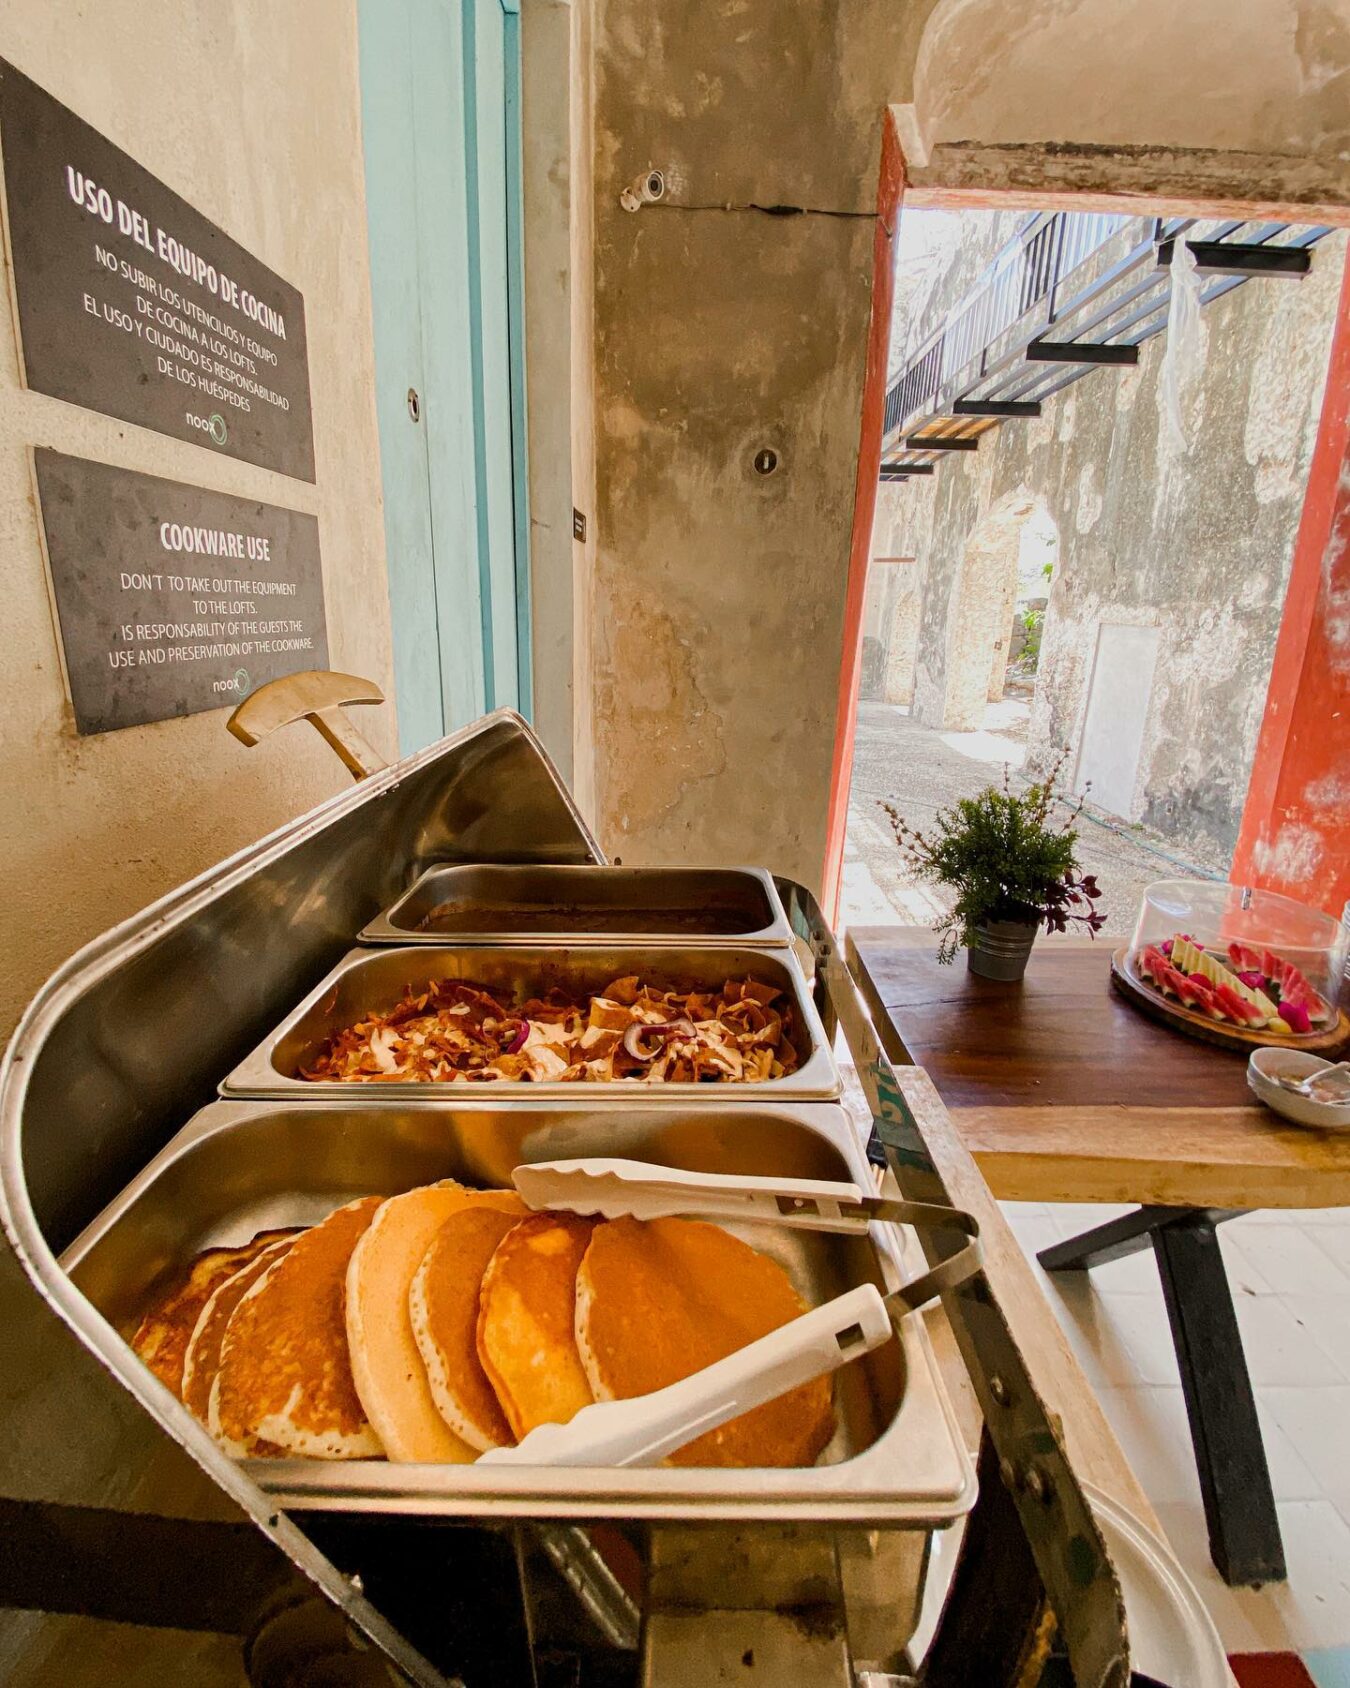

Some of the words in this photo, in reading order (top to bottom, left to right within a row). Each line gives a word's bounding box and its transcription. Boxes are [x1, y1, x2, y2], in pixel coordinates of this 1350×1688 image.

[67, 165, 113, 223] USO
[117, 200, 155, 253] DEL
[157, 228, 218, 294] EQUIPO
[220, 273, 240, 310] DE
[241, 290, 286, 340] COCINA
[95, 244, 117, 271] NO
[120, 260, 157, 296] SUBIR
[159, 283, 181, 309] LOS
[240, 333, 246, 347] Y
[247, 338, 277, 366] EQUIPO
[84, 293, 101, 317] EL
[103, 303, 132, 332] USO
[134, 319, 142, 337] Y
[146, 327, 199, 365] CIUDADO
[200, 354, 212, 373] ES
[214, 361, 290, 411] RESPONSABILIDAD
[136, 295, 154, 319] DE
[156, 307, 199, 344] COCINA
[201, 332, 209, 349] A
[210, 337, 228, 359] LOS
[229, 348, 258, 376] LOFTS.
[157, 356, 174, 377] DE
[176, 365, 196, 387] LOS
[198, 375, 250, 412] HUÉSPEDES
[186, 412, 218, 436] noox
[160, 522, 245, 559] COOKWARE
[246, 536, 271, 561] USE
[167, 576, 184, 591] TO
[184, 577, 211, 593] TAKE
[212, 579, 232, 593] OUT
[233, 580, 252, 594] THE
[252, 581, 296, 596] EQUIPMENT
[193, 600, 207, 614] TO
[208, 600, 228, 614] THE
[229, 601, 258, 614] LOFTS.
[121, 625, 133, 641] IS
[136, 622, 226, 640] RESPONSABILITY
[228, 622, 239, 635] OF
[241, 621, 258, 635] THE
[259, 620, 288, 634] GUESTS
[289, 620, 303, 632] THE
[108, 650, 136, 668] USE
[139, 648, 166, 665] AND
[168, 643, 240, 662] PRESERVATION
[241, 642, 253, 655] OF
[254, 640, 271, 653] THE
[213, 678, 240, 692] noox
